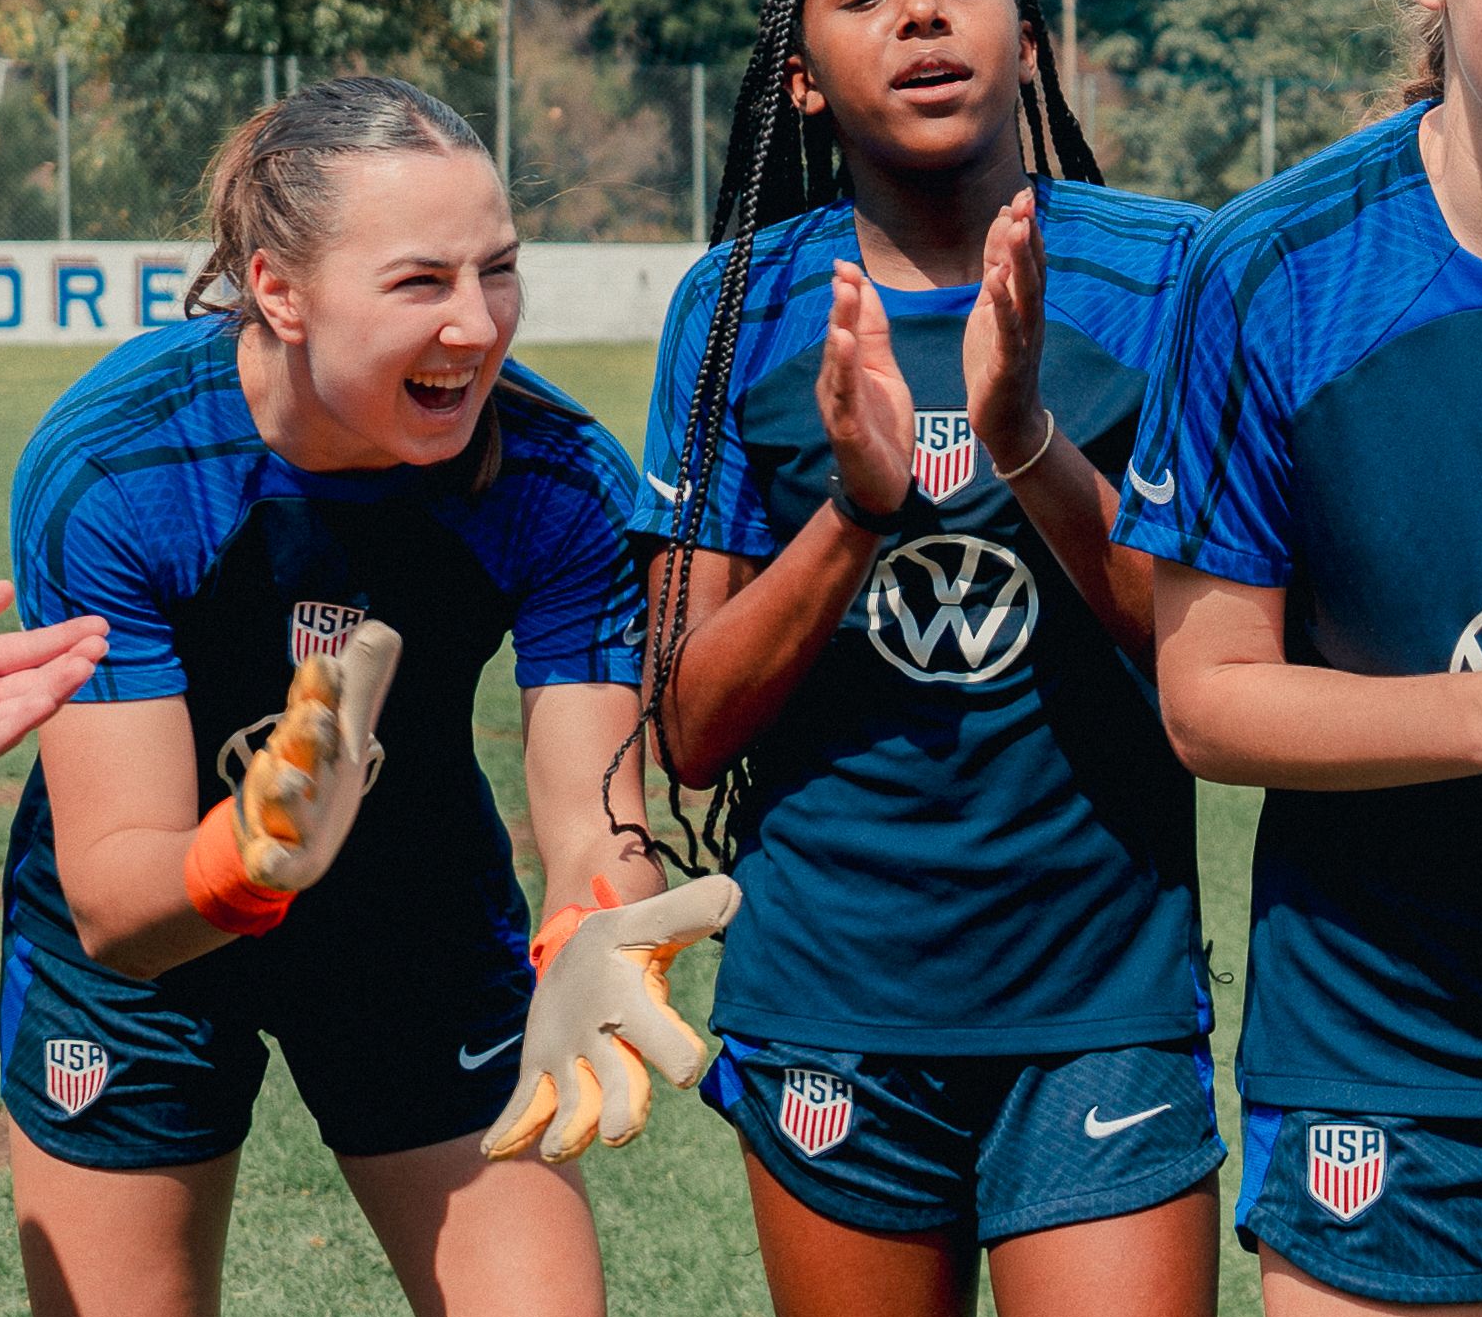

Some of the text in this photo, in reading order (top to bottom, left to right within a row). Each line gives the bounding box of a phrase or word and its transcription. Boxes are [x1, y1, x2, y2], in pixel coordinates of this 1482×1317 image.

[298, 604, 361, 635] USA
[51, 1043, 104, 1072] USA
[789, 1070, 848, 1104] USA
[1314, 1129, 1377, 1164] USA
